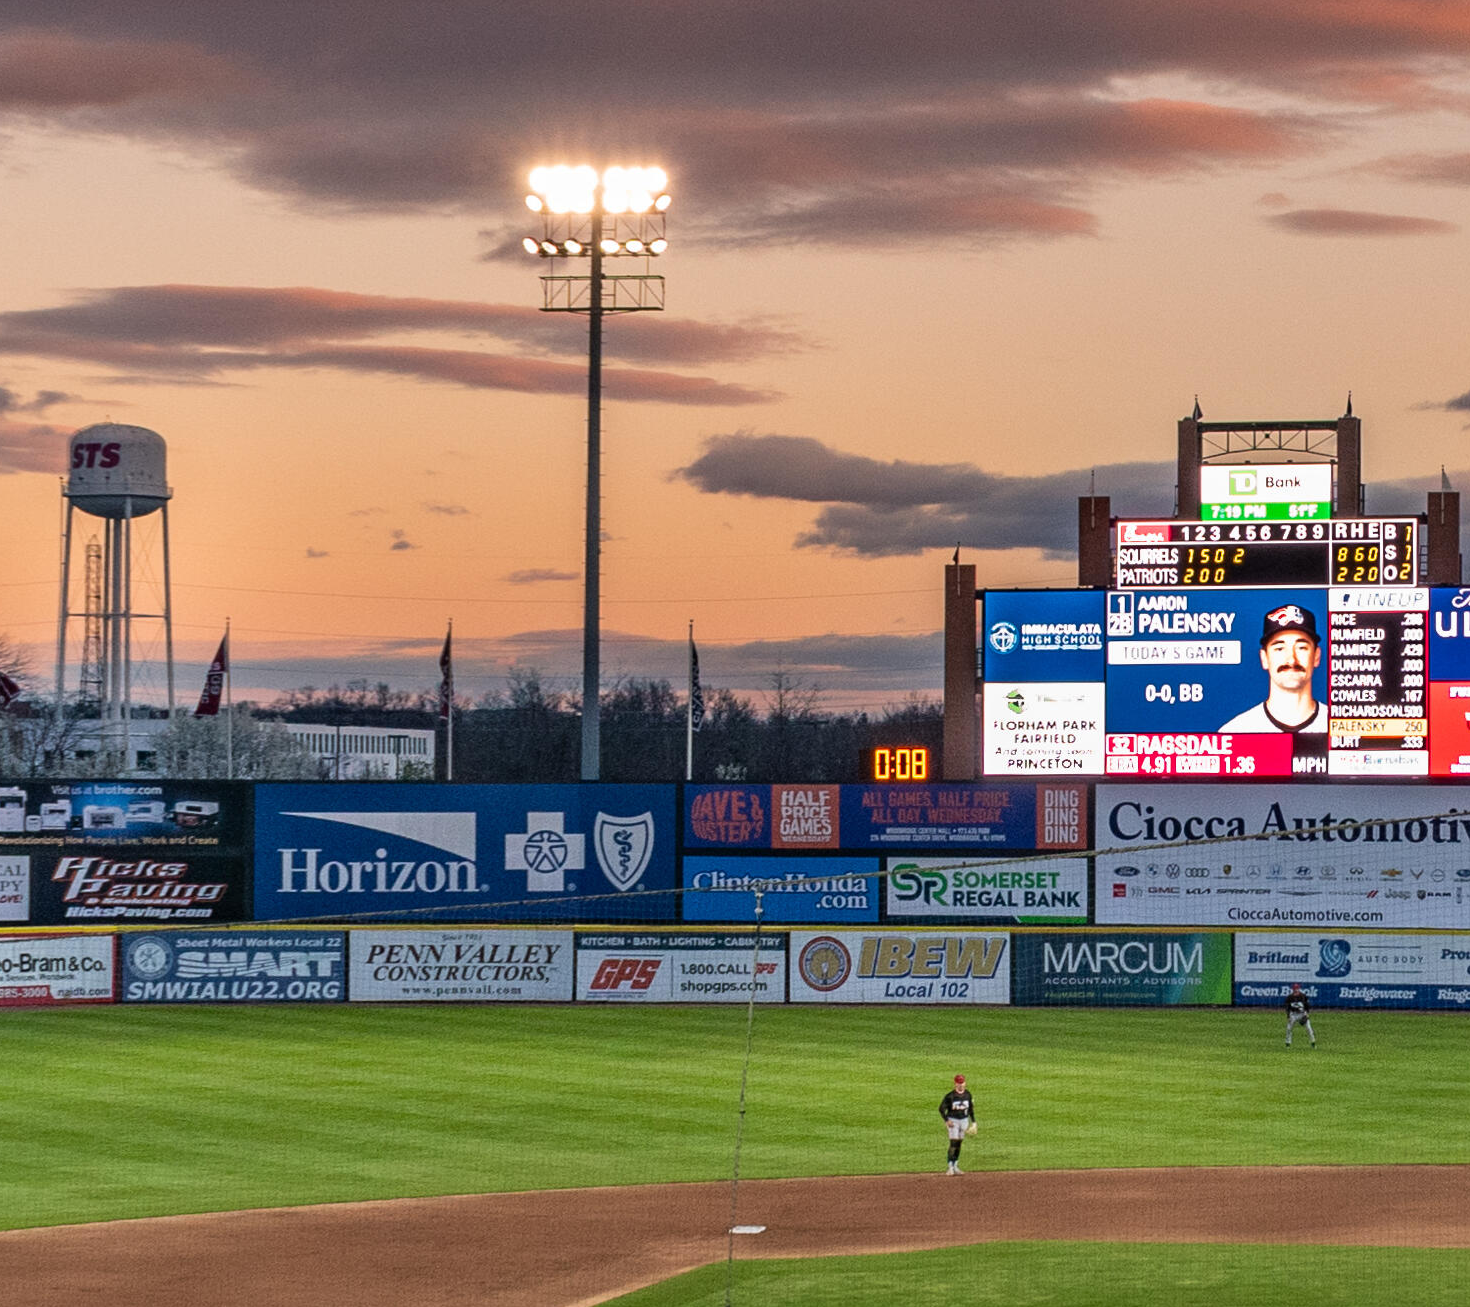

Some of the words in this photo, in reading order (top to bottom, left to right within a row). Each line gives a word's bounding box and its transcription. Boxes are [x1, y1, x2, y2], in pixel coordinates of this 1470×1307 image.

[1211, 505, 1241, 518] 7:19
[1244, 505, 1267, 517] PM
[1120, 548, 1178, 564] SQUIRRELS
[1120, 568, 1178, 584] PATRIOTS
[1138, 596, 1187, 611] AARON
[1138, 613, 1236, 633] PALENSKY
[1331, 614, 1356, 626] RICE
[1022, 636, 1051, 644] HIGH
[1055, 636, 1102, 644] SCHOOL
[1331, 629, 1385, 641] RUMFIELD
[1331, 644, 1380, 656] RAMIREZ
[1014, 734, 1076, 743] FAIRFIELD
[1137, 736, 1233, 755] RAGSDALE
[875, 749, 927, 779] 0:08
[1008, 759, 1083, 769] PRINCETON
[1293, 757, 1326, 773] MPH
[781, 790, 830, 806] HALF
[1045, 790, 1079, 807] DING
[781, 807, 830, 819] PRICE
[1045, 808, 1079, 825] DING
[1109, 801, 1245, 841] Ciocca
[780, 818, 832, 837] GAMES
[1045, 826, 1079, 843] DING
[51, 856, 188, 881] Hicks
[276, 847, 480, 894] Horizon
[692, 871, 868, 894] ClintonHonda
[952, 871, 1060, 889] SOMERSET
[63, 879, 228, 903] Paving
[952, 890, 1017, 907] REGAL
[1024, 891, 1080, 908] BANK
[815, 894, 869, 909] .com
[66, 907, 212, 918] HicksPaving.com
[1227, 907, 1383, 922] CioccaAutomotive.com
[176, 938, 209, 948] Sheet
[211, 938, 243, 948] Metal
[246, 938, 293, 948] Workers
[294, 938, 325, 948] Local
[328, 938, 341, 948] 22
[366, 944, 446, 965] PENN
[453, 944, 560, 964] VALLEY
[856, 936, 1008, 980] IBEW
[1043, 941, 1203, 974] MARCUM
[1247, 951, 1310, 966] Britland
[1357, 956, 1388, 964] AUTO
[1394, 955, 1424, 964] BODY
[176, 951, 340, 978] SMART
[372, 965, 550, 985] CONSTRUCTORS,
[590, 958, 662, 991] GPS
[128, 981, 339, 1001] SMWIALU22.ORG
[885, 982, 932, 998] Local
[939, 982, 969, 998] 102
